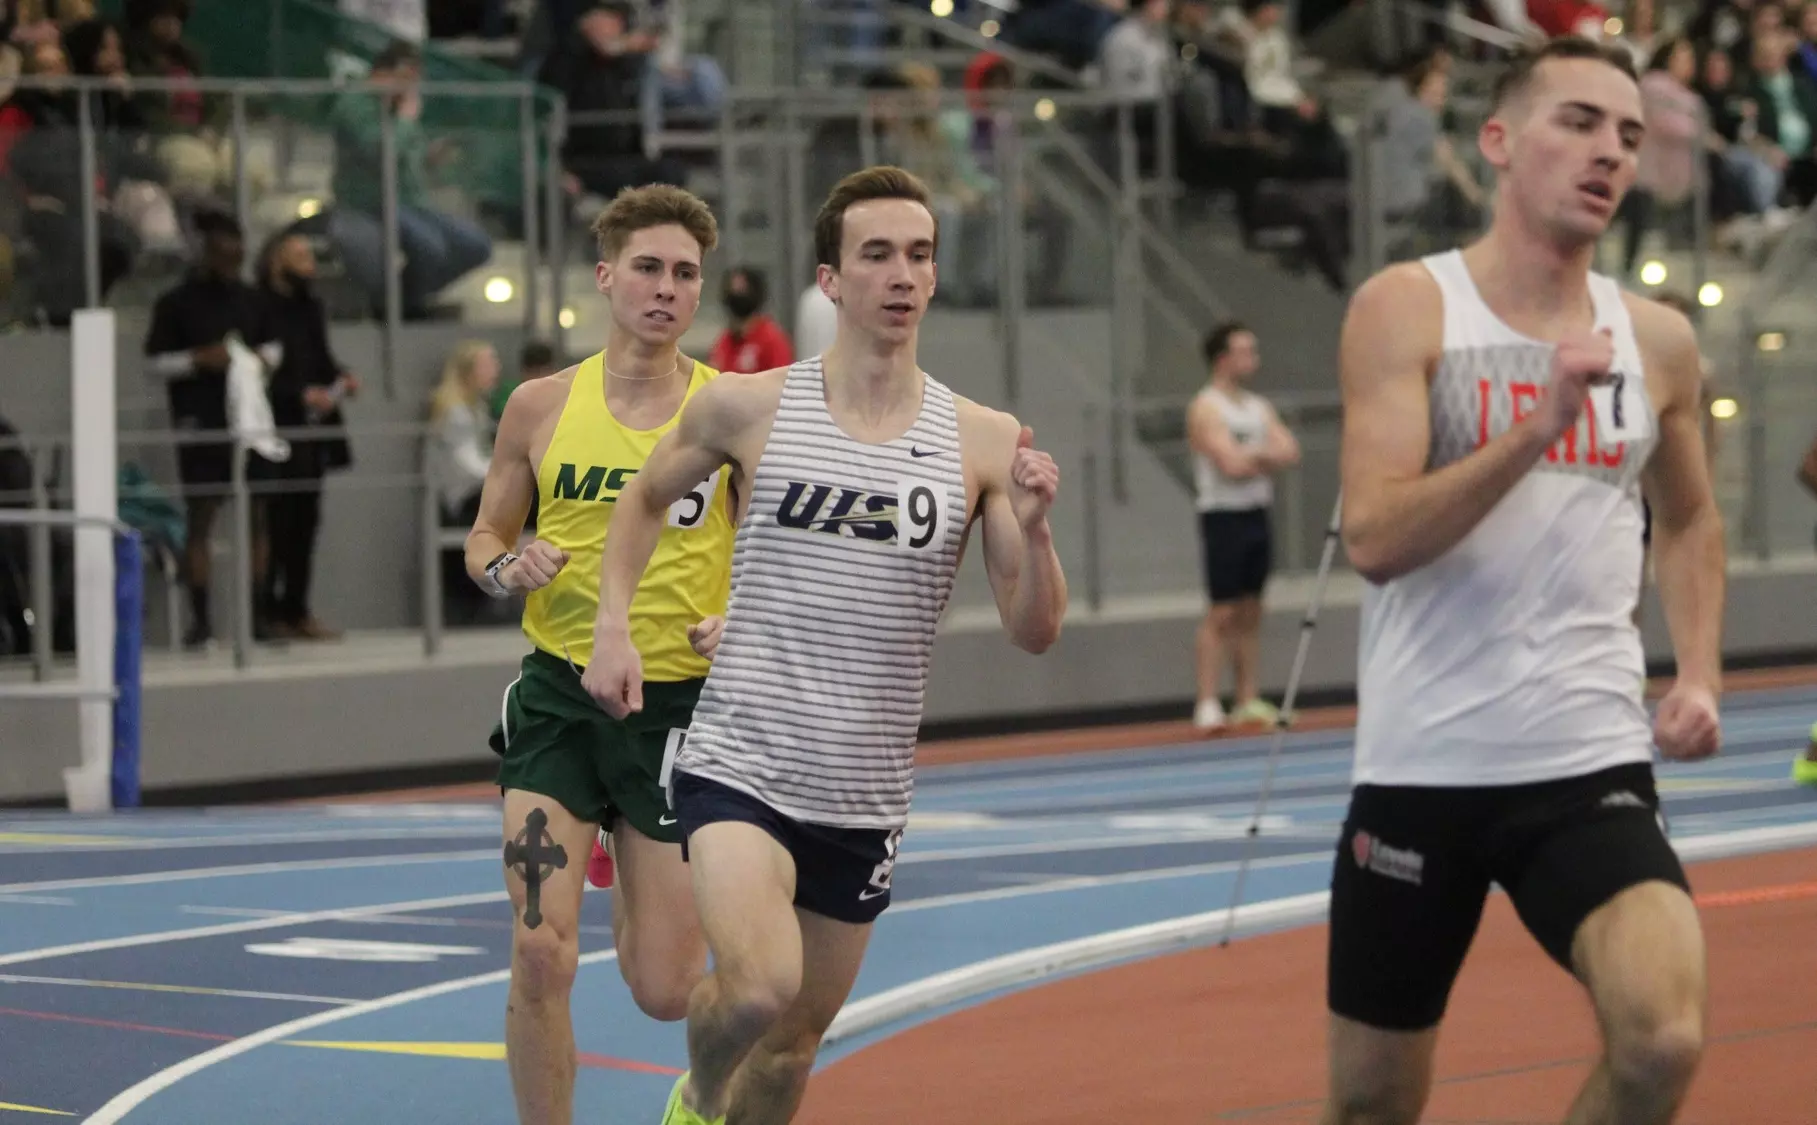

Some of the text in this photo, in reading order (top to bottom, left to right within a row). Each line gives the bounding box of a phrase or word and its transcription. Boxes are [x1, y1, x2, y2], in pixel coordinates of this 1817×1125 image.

[1585, 372, 1625, 428] 7
[678, 475, 710, 526] 5
[776, 482, 898, 541] UIS
[908, 486, 937, 548] 9
